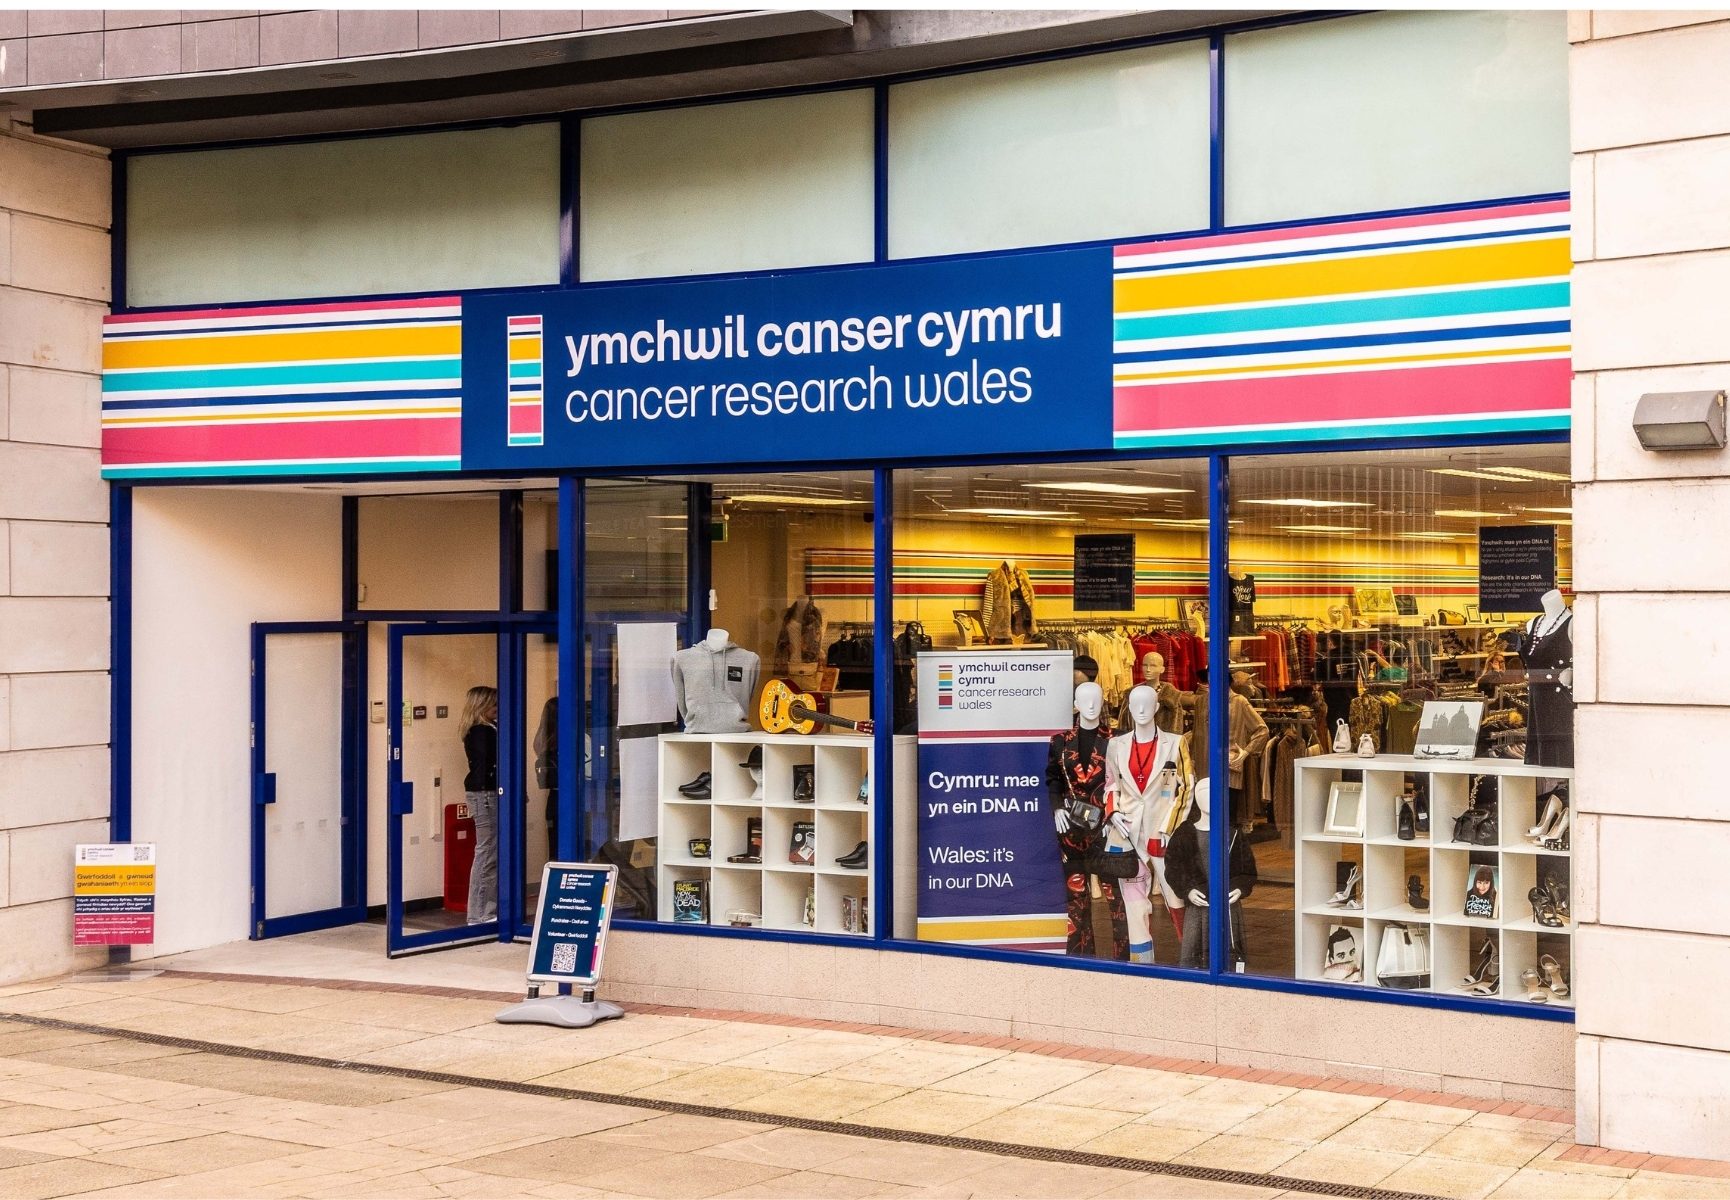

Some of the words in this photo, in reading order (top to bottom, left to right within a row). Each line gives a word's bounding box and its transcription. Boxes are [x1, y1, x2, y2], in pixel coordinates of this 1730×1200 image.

[564, 315, 749, 378] ymchwil
[756, 314, 912, 357] canser
[917, 303, 1062, 357] cymru
[565, 384, 706, 423] cancer
[711, 366, 892, 417] research
[904, 359, 1033, 408] wales
[958, 662, 1009, 674] ymchwil
[1010, 663, 1051, 672] canser
[958, 676, 995, 686] cymru
[958, 688, 997, 698] cancer
[998, 686, 1046, 697] research
[958, 700, 992, 710] wales
[928, 771, 1000, 793] Cymru:
[1003, 775, 1040, 788] mae
[928, 802, 949, 818] yn
[951, 799, 977, 814] ein
[981, 797, 1020, 813] DNA
[1024, 797, 1039, 812] ni
[928, 846, 990, 864] Wales:
[993, 848, 1014, 863] it's
[928, 875, 942, 890] in
[946, 877, 973, 889] our
[976, 873, 1014, 888] DNA
[677, 899, 701, 907] DEAD
[1466, 900, 1493, 911] FRENCH
